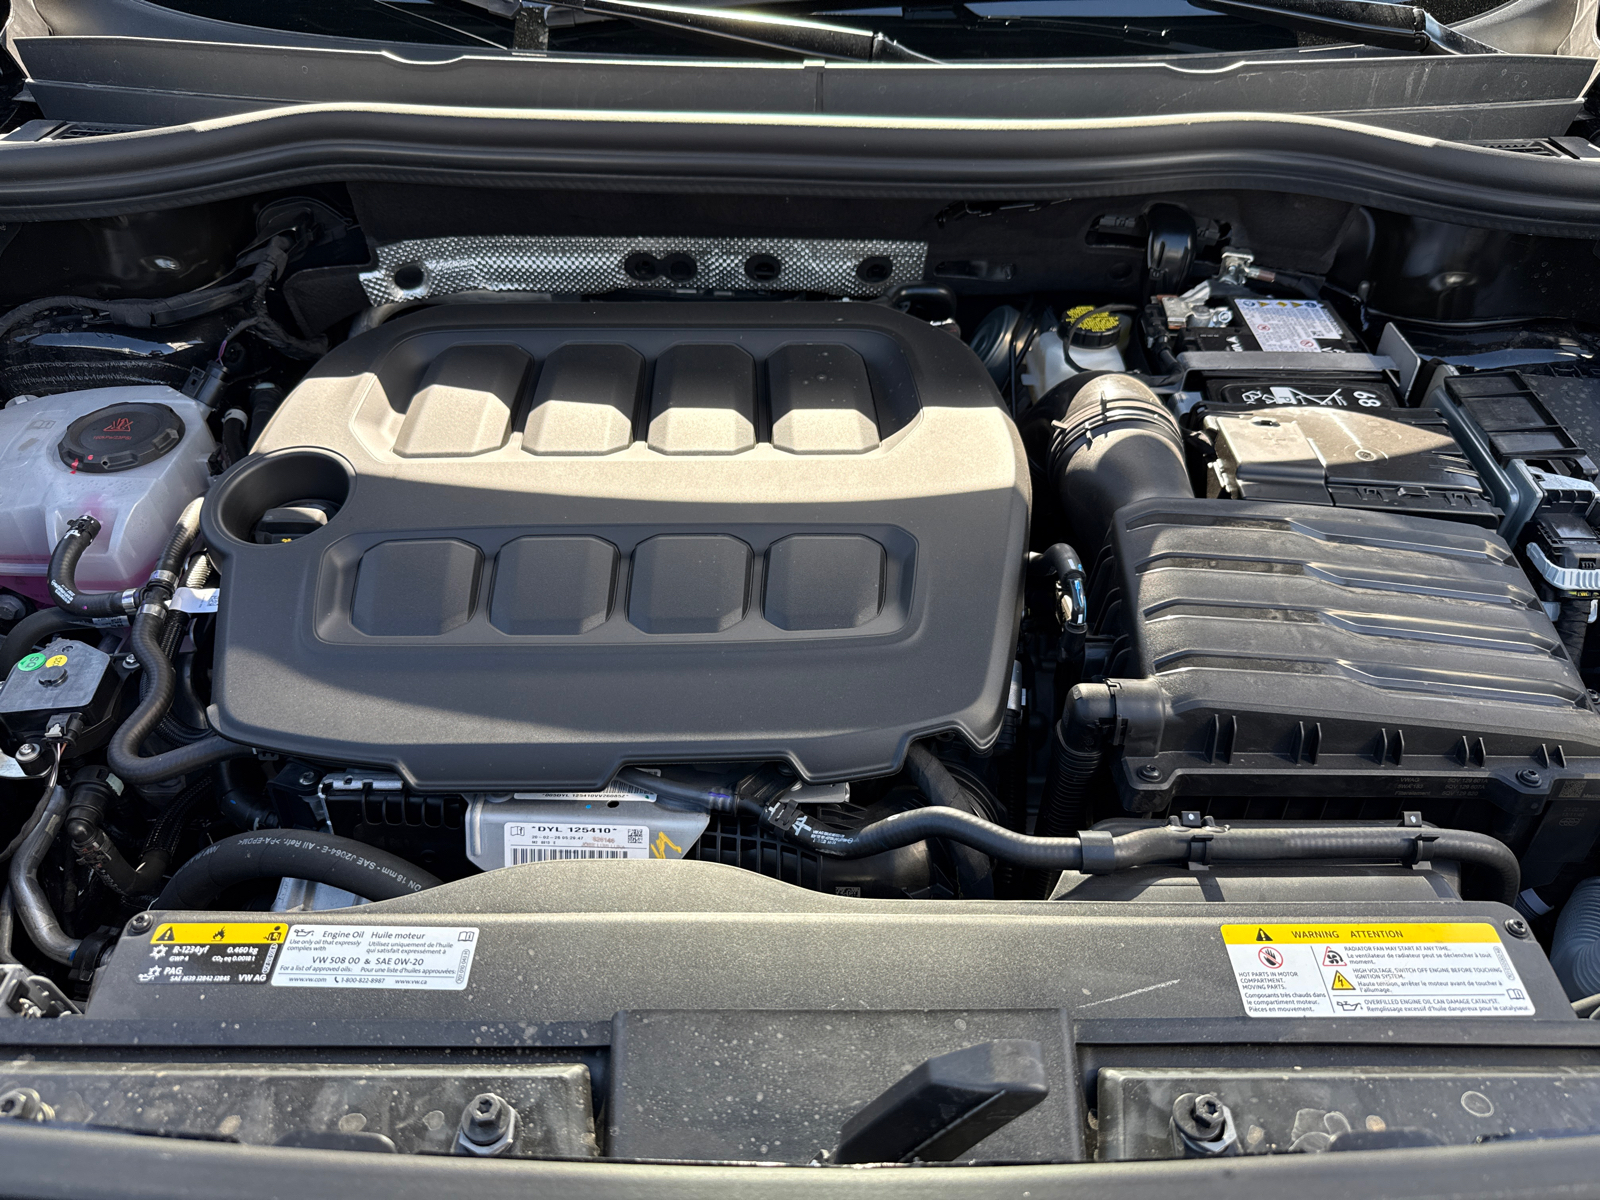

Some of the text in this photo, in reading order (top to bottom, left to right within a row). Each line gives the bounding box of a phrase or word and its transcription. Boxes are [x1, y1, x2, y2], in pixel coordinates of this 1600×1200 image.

[302, 841, 316, 851] All
[321, 846, 357, 861] J2064-E
[357, 857, 375, 871] SAE
[381, 867, 396, 880] mm
[397, 875, 408, 886] 18
[407, 881, 422, 892] DN
[322, 931, 350, 939] Engine
[371, 931, 393, 939] Huile
[1350, 930, 1404, 938] ATTENTION
[172, 945, 210, 956] R-1234yf
[249, 947, 258, 955] kg
[312, 956, 328, 964] VW
[394, 958, 424, 966] 0W-20
[164, 967, 183, 975] PAG
